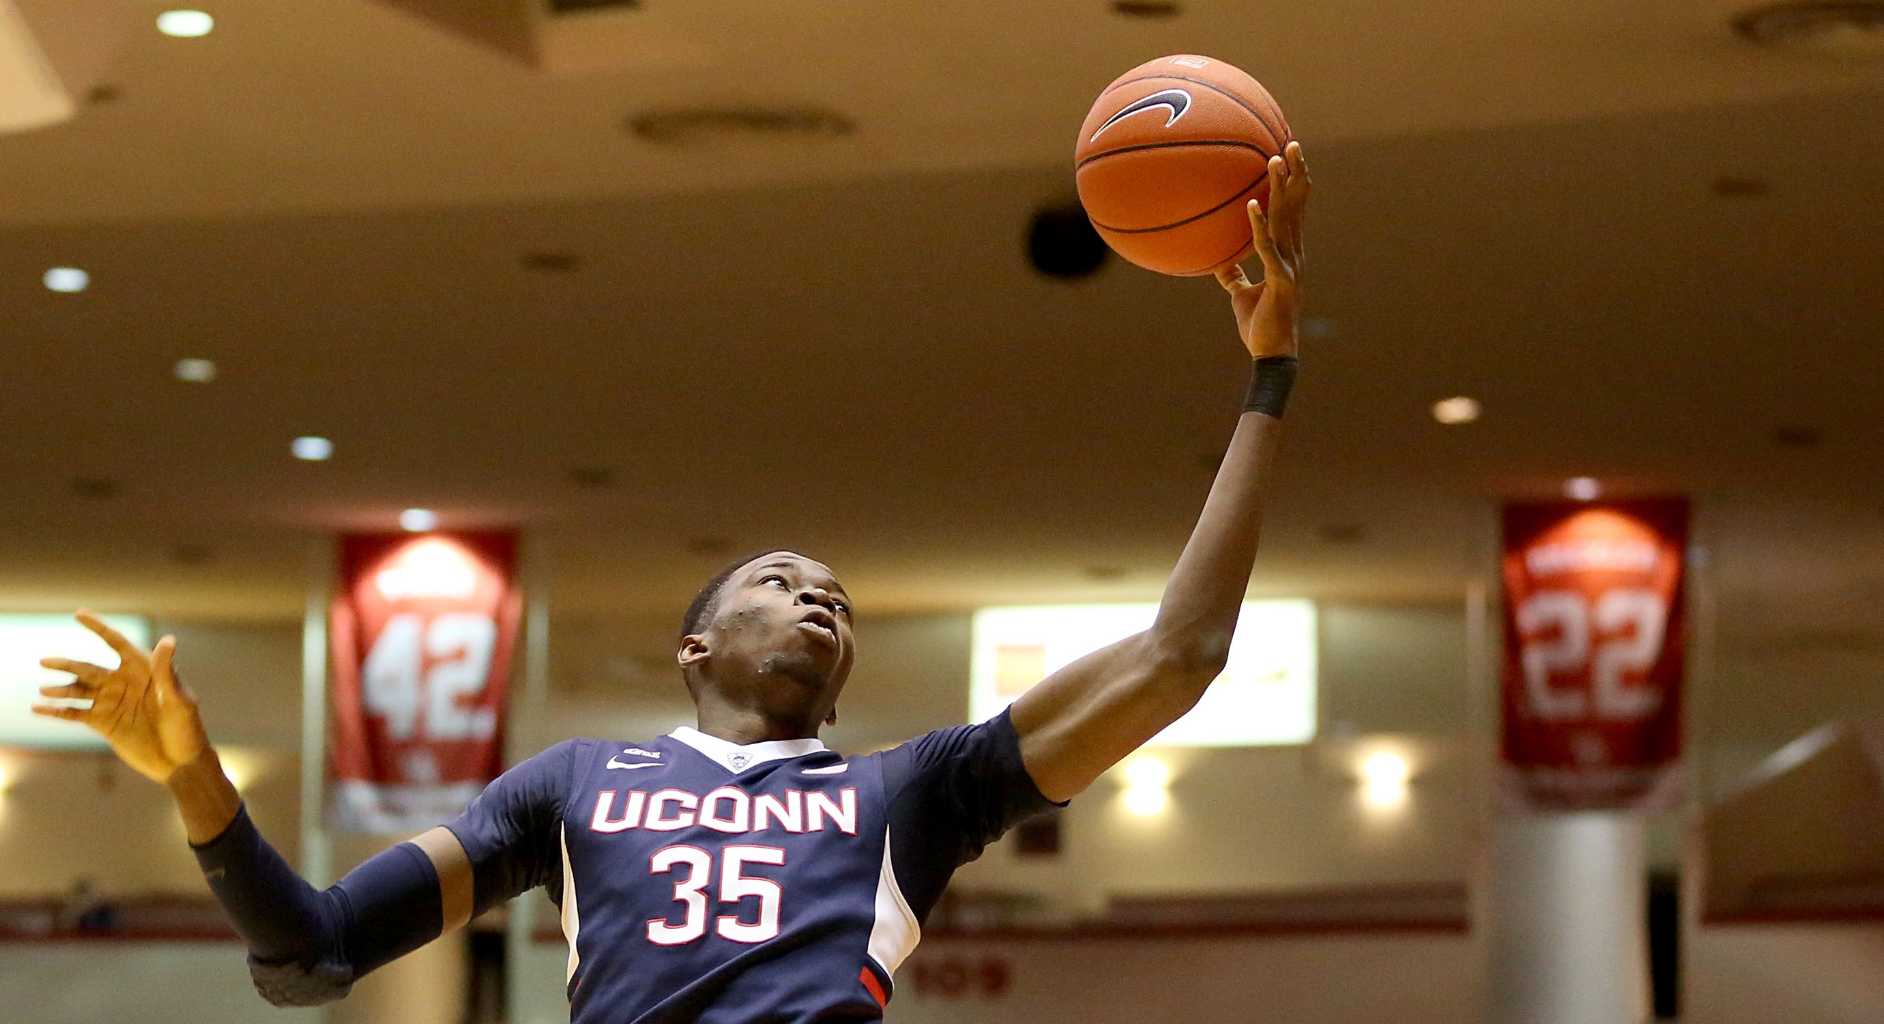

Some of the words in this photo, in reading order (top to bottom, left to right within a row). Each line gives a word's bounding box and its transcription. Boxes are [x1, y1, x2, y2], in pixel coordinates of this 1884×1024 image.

[364, 611, 496, 742] 42
[1517, 589, 1667, 719] 22
[591, 785, 858, 836] UCONN
[646, 845, 785, 947] 35
